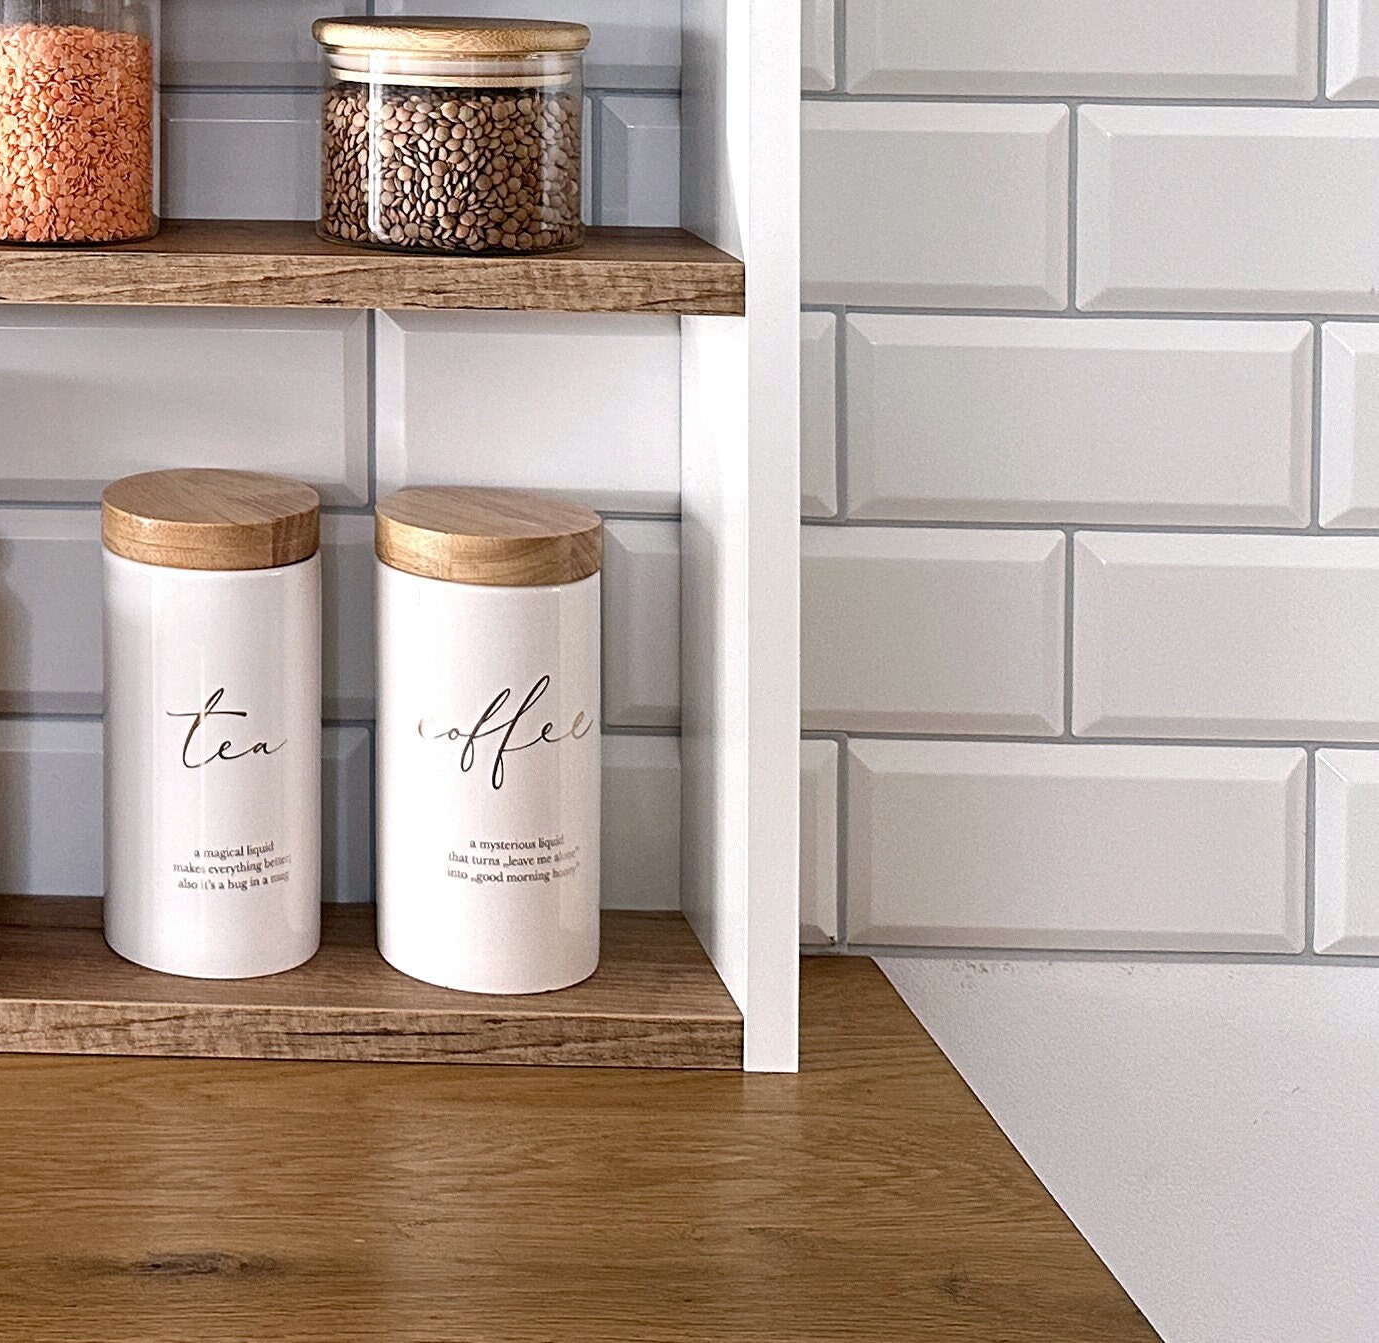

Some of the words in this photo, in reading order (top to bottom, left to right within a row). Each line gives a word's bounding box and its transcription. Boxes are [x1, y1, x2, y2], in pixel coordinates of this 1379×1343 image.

[166, 687, 288, 769] tea
[193, 849, 200, 858] a
[203, 845, 245, 860] magical
[246, 840, 275, 858] liquid
[469, 840, 476, 849] a
[479, 839, 536, 852] mysterious
[538, 833, 565, 850] liquid
[448, 851, 470, 864] that
[472, 855, 501, 866] turns
[536, 855, 552, 865] me
[208, 860, 263, 876] everything
[447, 866, 469, 879] into
[506, 870, 551, 883] morning
[178, 878, 198, 890] also
[218, 881, 225, 890] a
[249, 875, 260, 887] in
[262, 877, 269, 885] a
